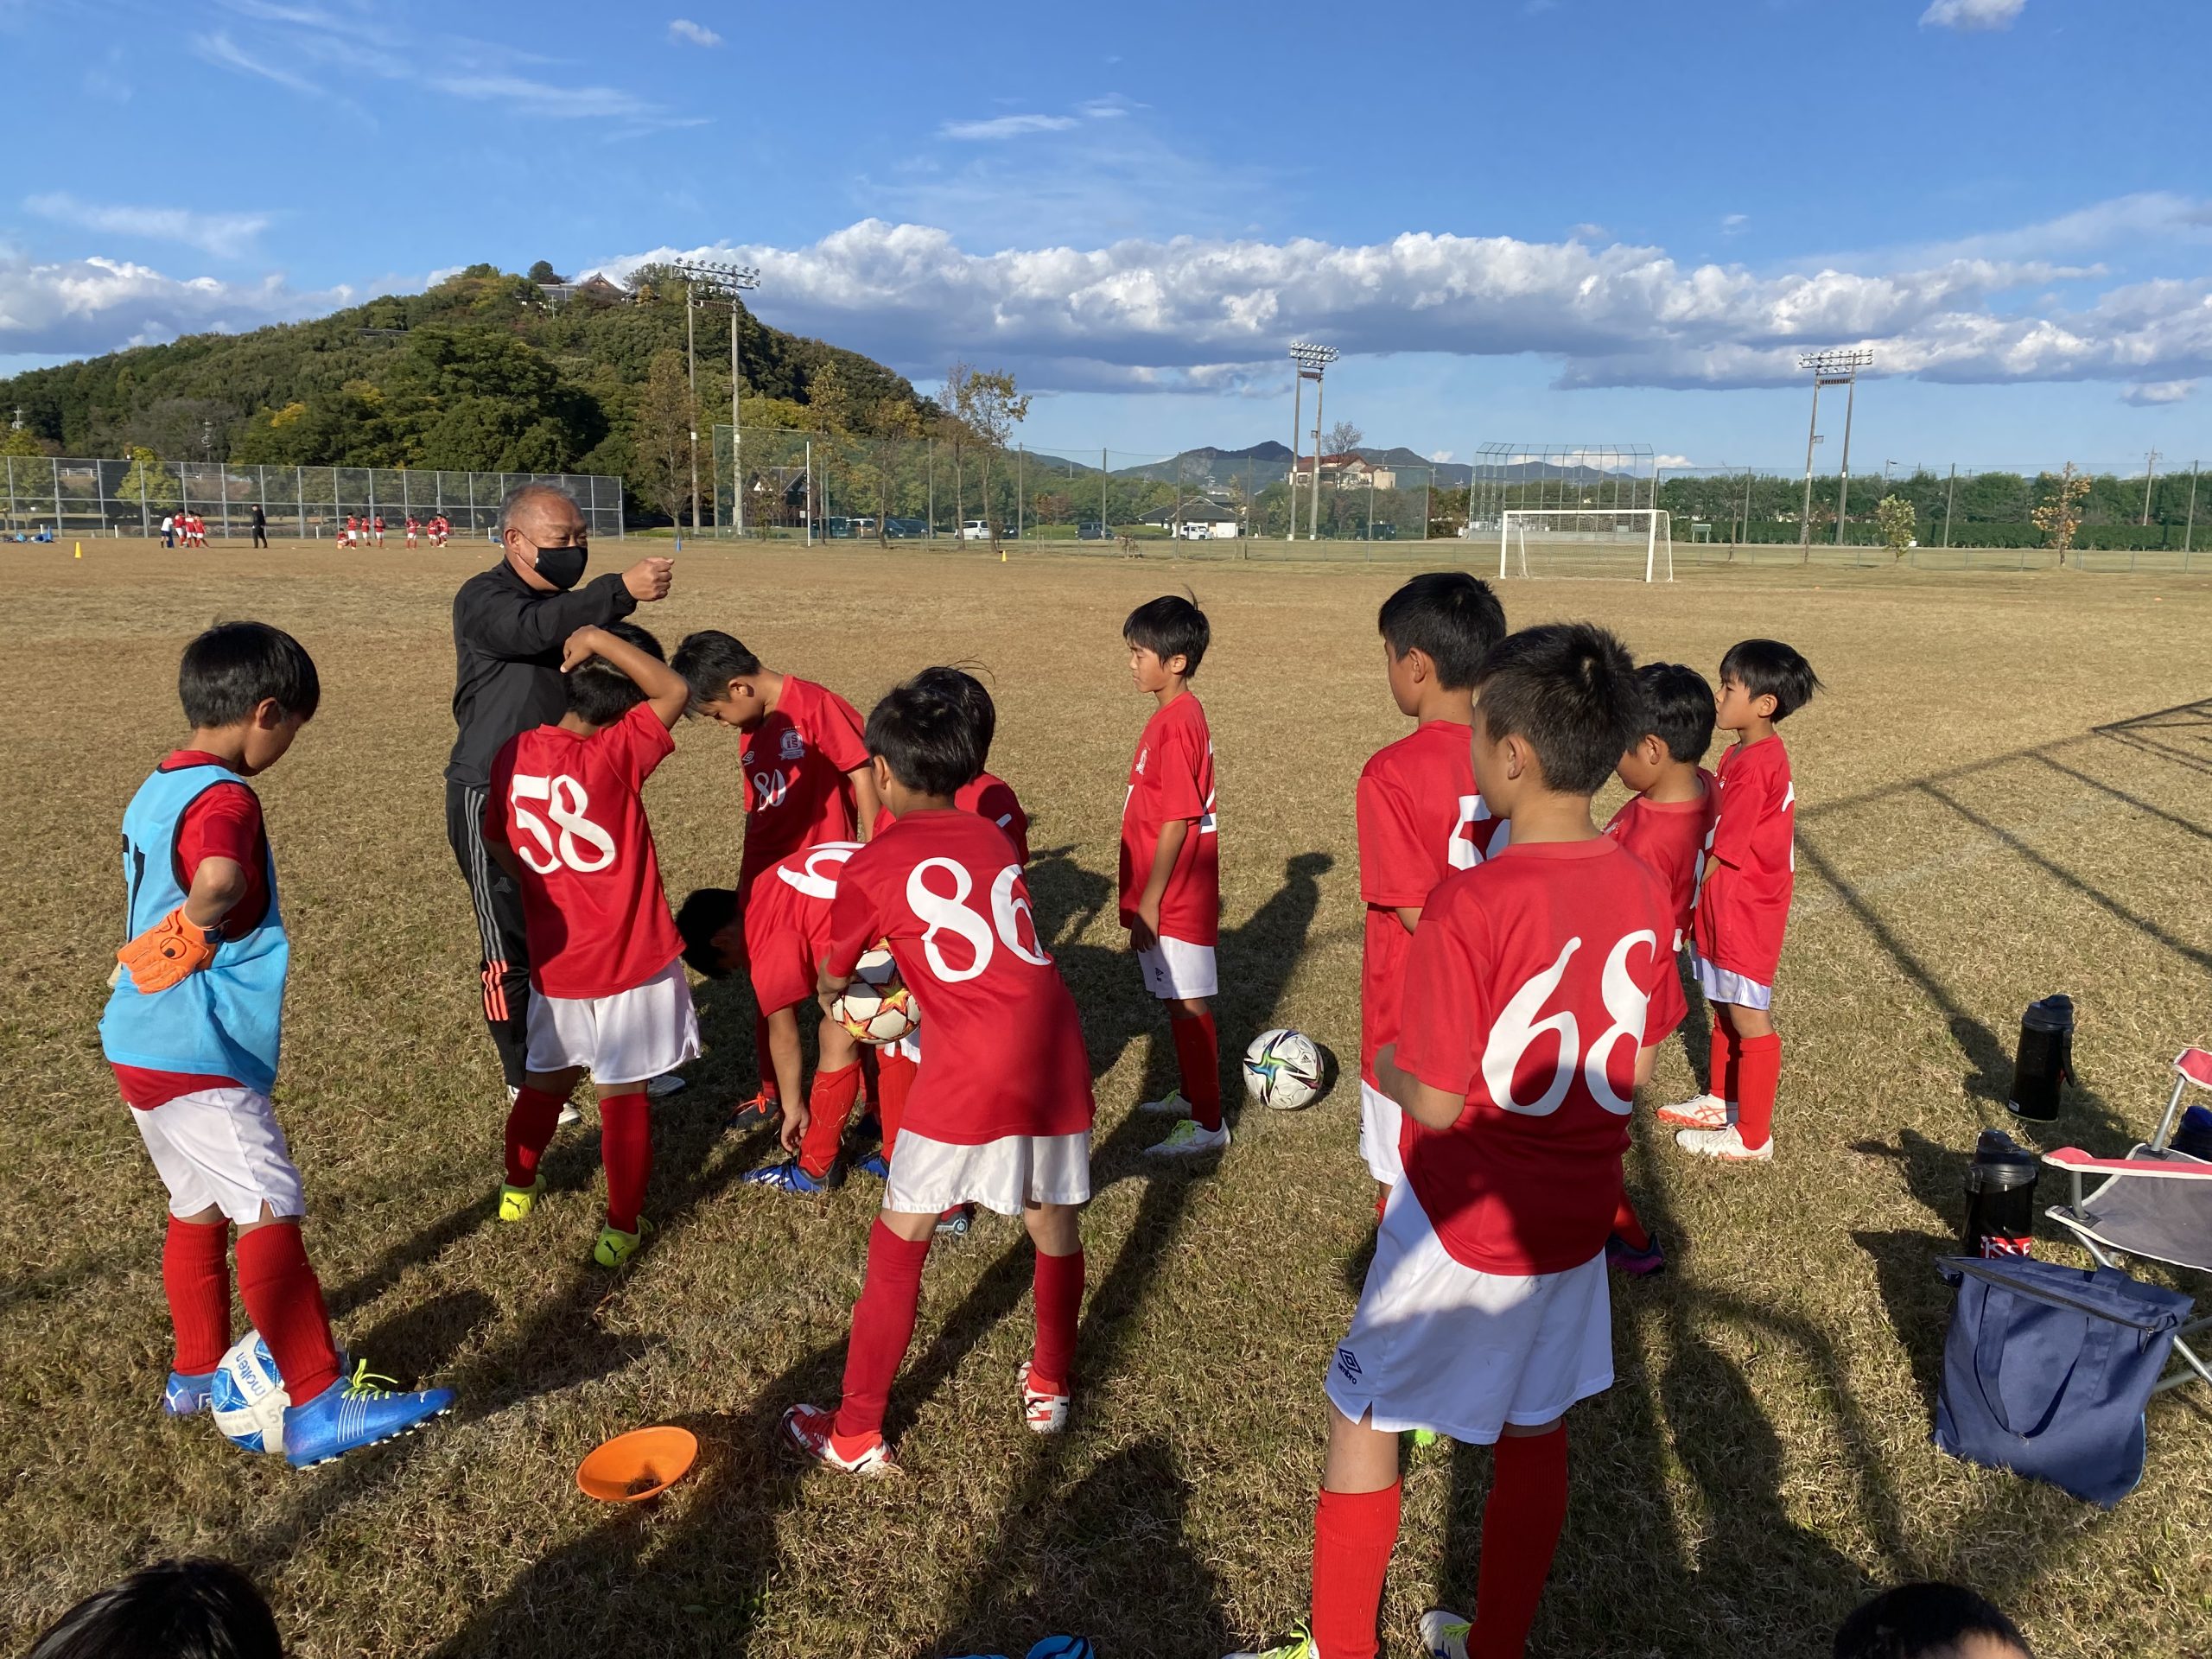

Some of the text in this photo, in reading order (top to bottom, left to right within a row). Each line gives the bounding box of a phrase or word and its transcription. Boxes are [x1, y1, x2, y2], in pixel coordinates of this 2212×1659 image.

[510, 774, 615, 874] 58
[753, 768, 786, 812] 80
[1447, 794, 1511, 871] 5
[906, 855, 1052, 982] 86
[1480, 928, 1657, 1116] 68
[235, 1351, 266, 1396] molten
[1338, 1361, 1357, 1385] umbro
